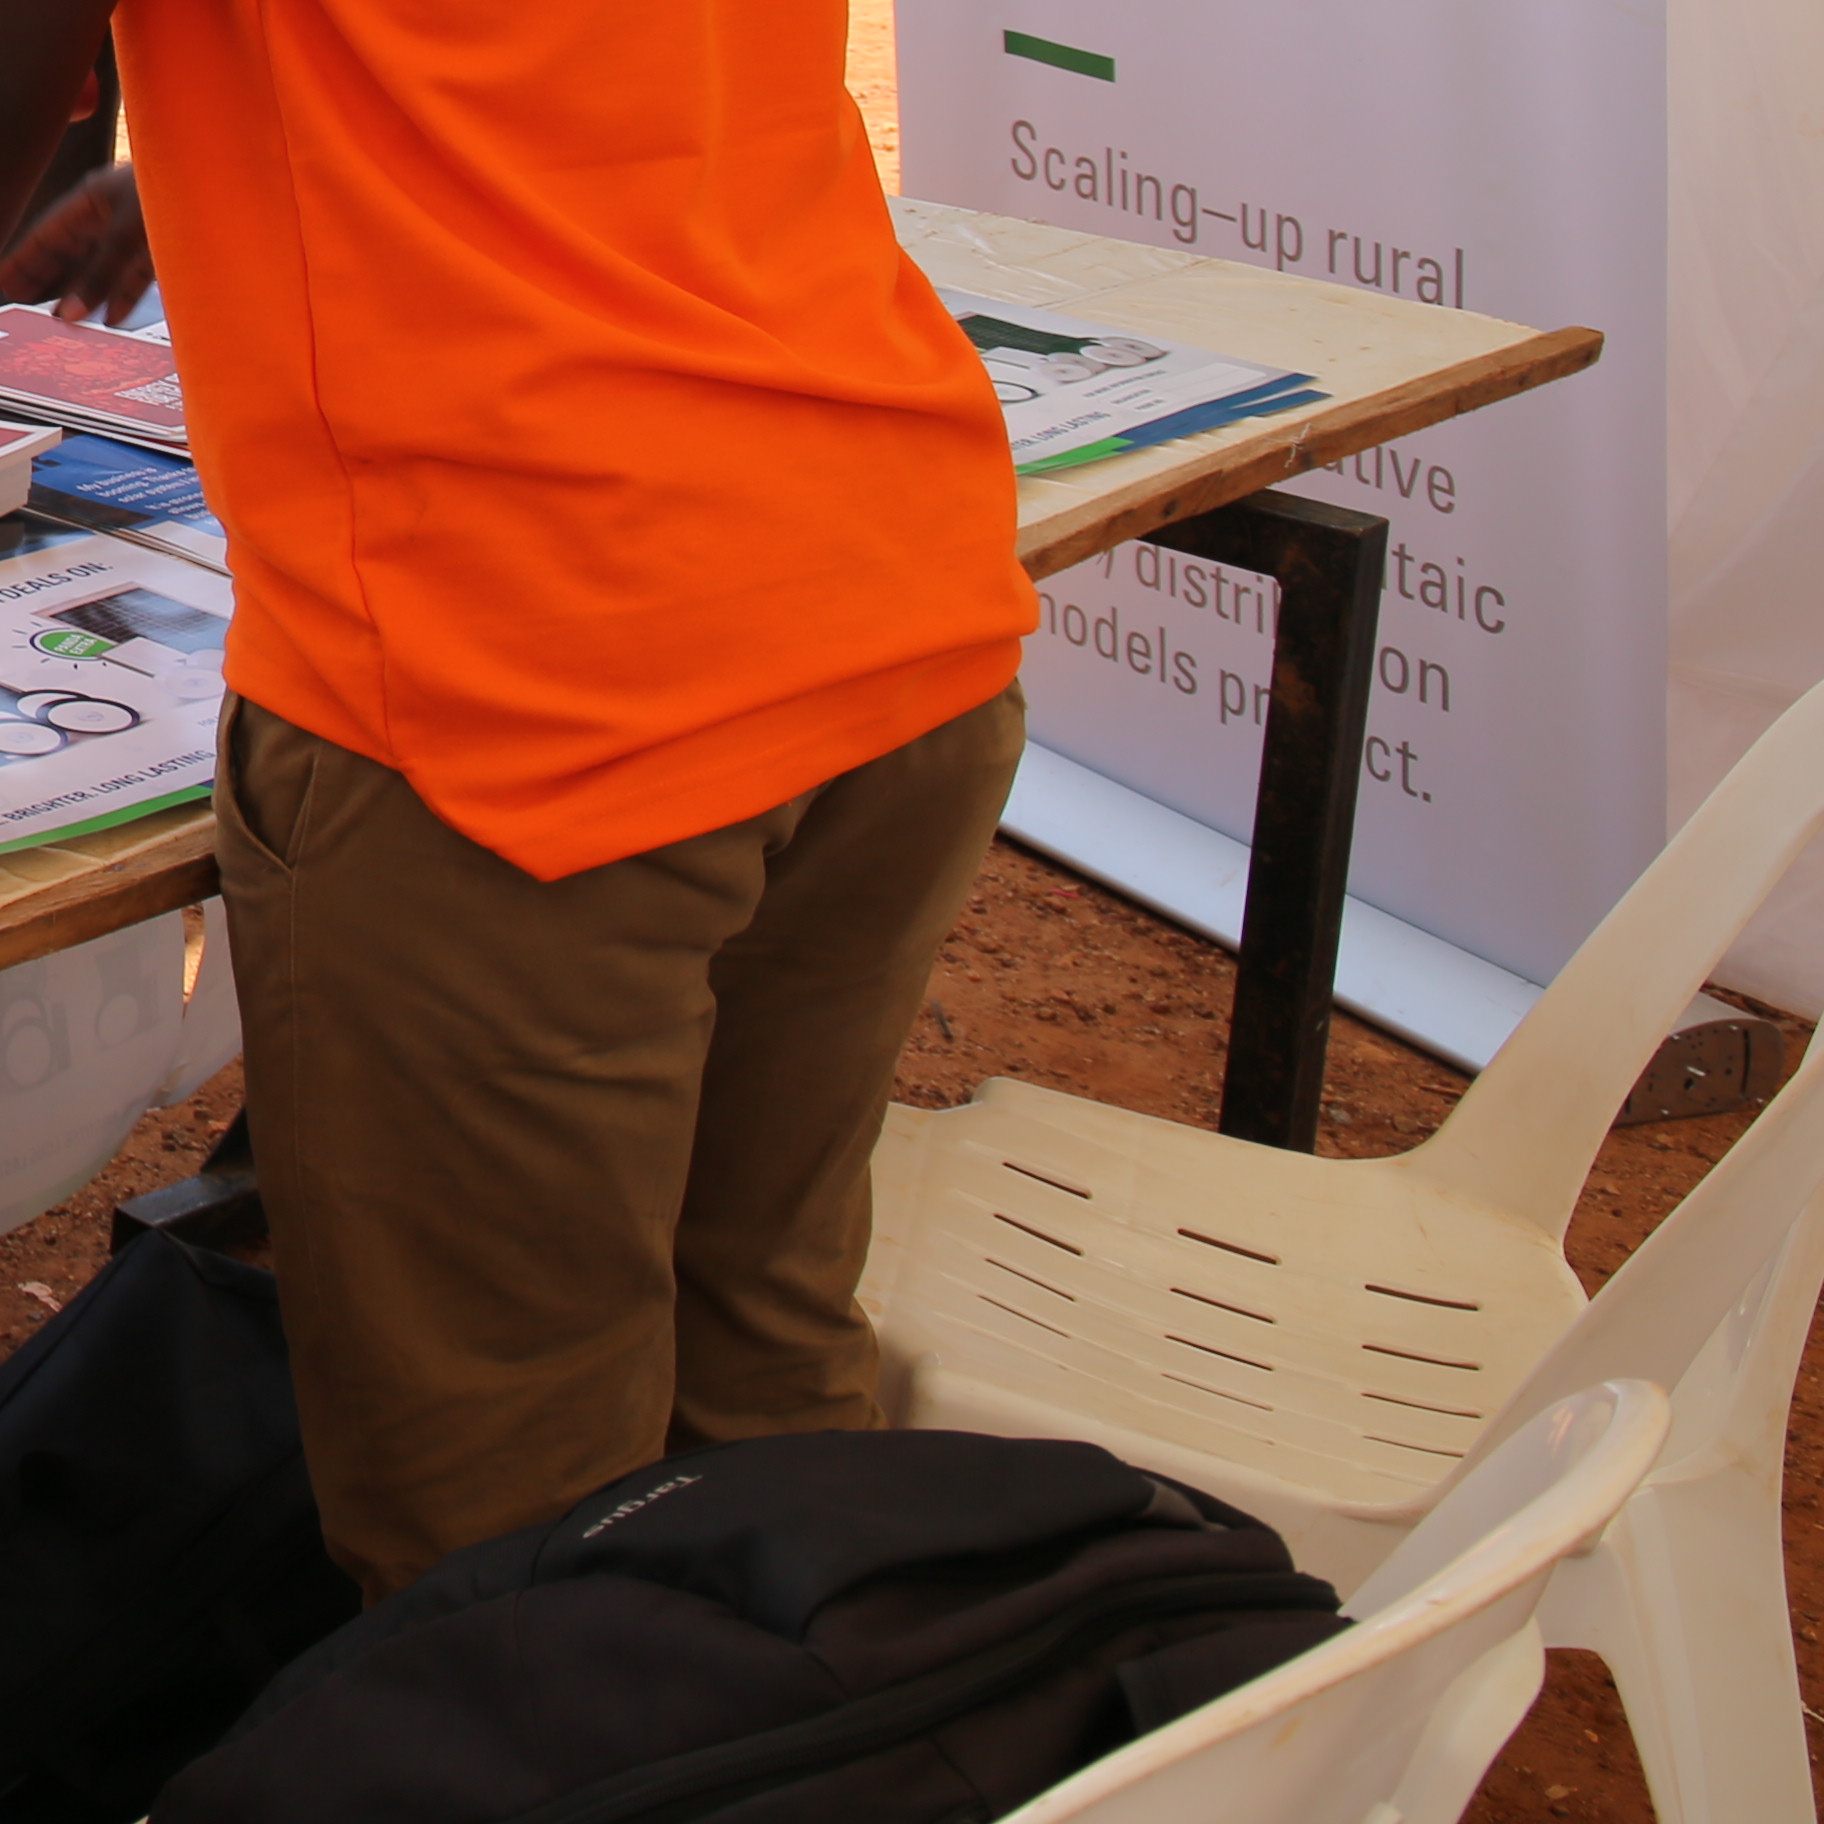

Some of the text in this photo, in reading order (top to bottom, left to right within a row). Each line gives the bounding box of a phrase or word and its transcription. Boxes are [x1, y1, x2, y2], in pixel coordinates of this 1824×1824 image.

[1327, 226, 1467, 309] rural
[66, 562, 113, 578] ON:
[6, 789, 98, 823] BRIGHTER.
[90, 774, 145, 794] LONG
[138, 750, 215, 778] LASTING
